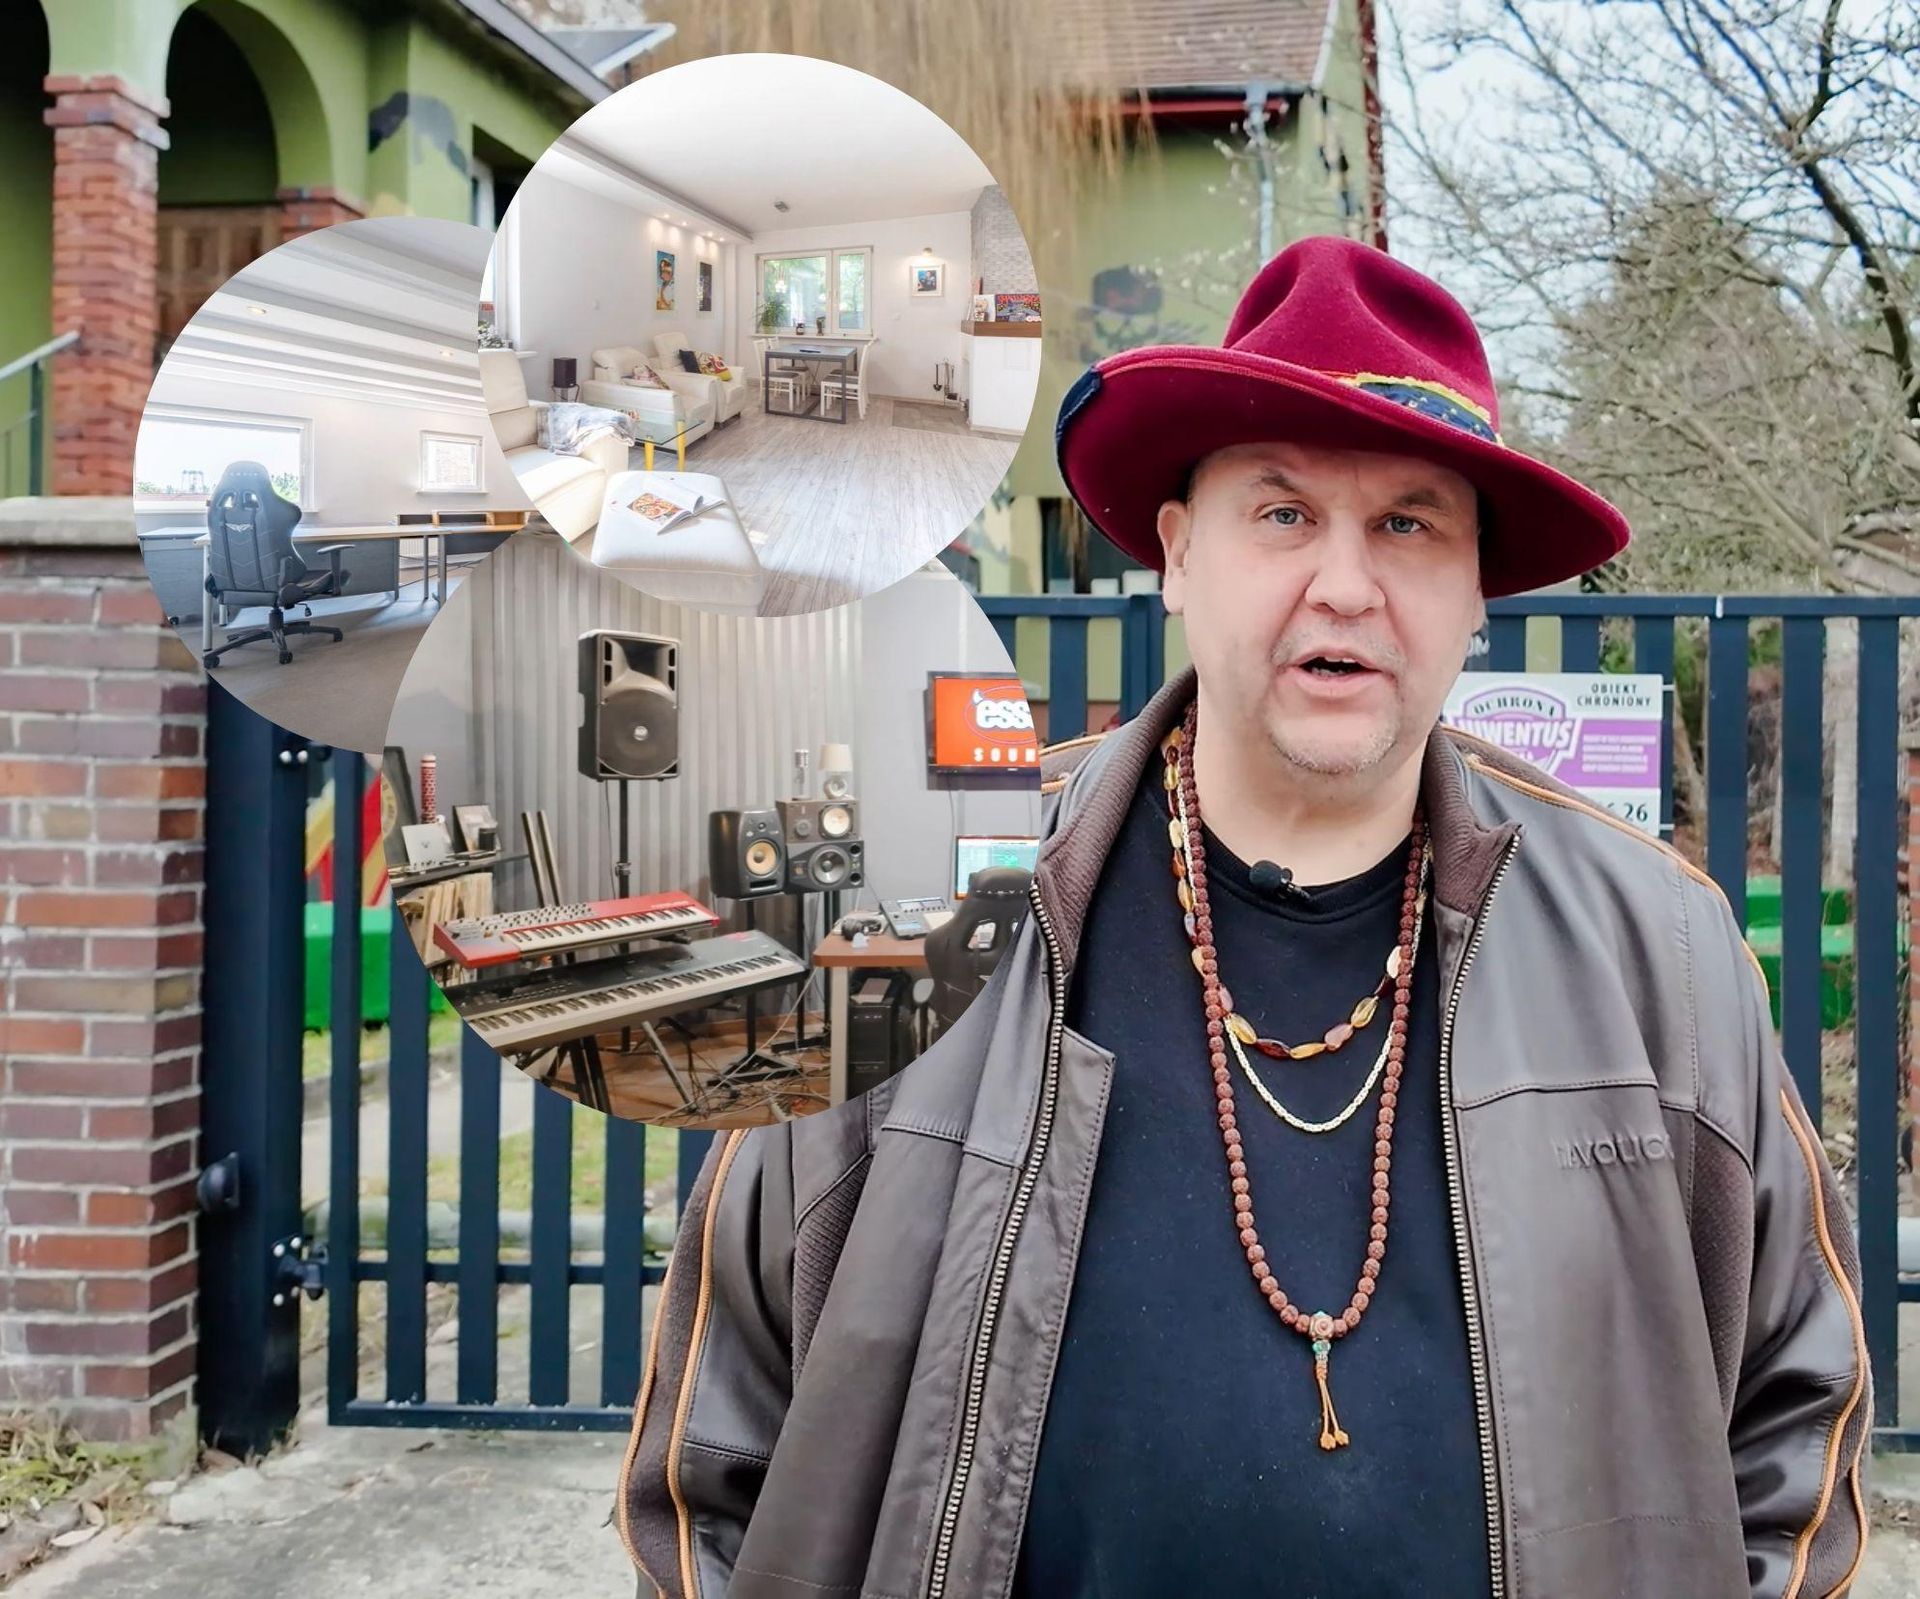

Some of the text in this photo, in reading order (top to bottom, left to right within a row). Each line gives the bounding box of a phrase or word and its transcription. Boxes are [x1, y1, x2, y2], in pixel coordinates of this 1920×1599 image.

[1591, 683, 1636, 694] OBIEKT
[1576, 696, 1651, 707] CHRONIONY
[976, 699, 1034, 728] ess
[1623, 802, 1648, 822] 26
